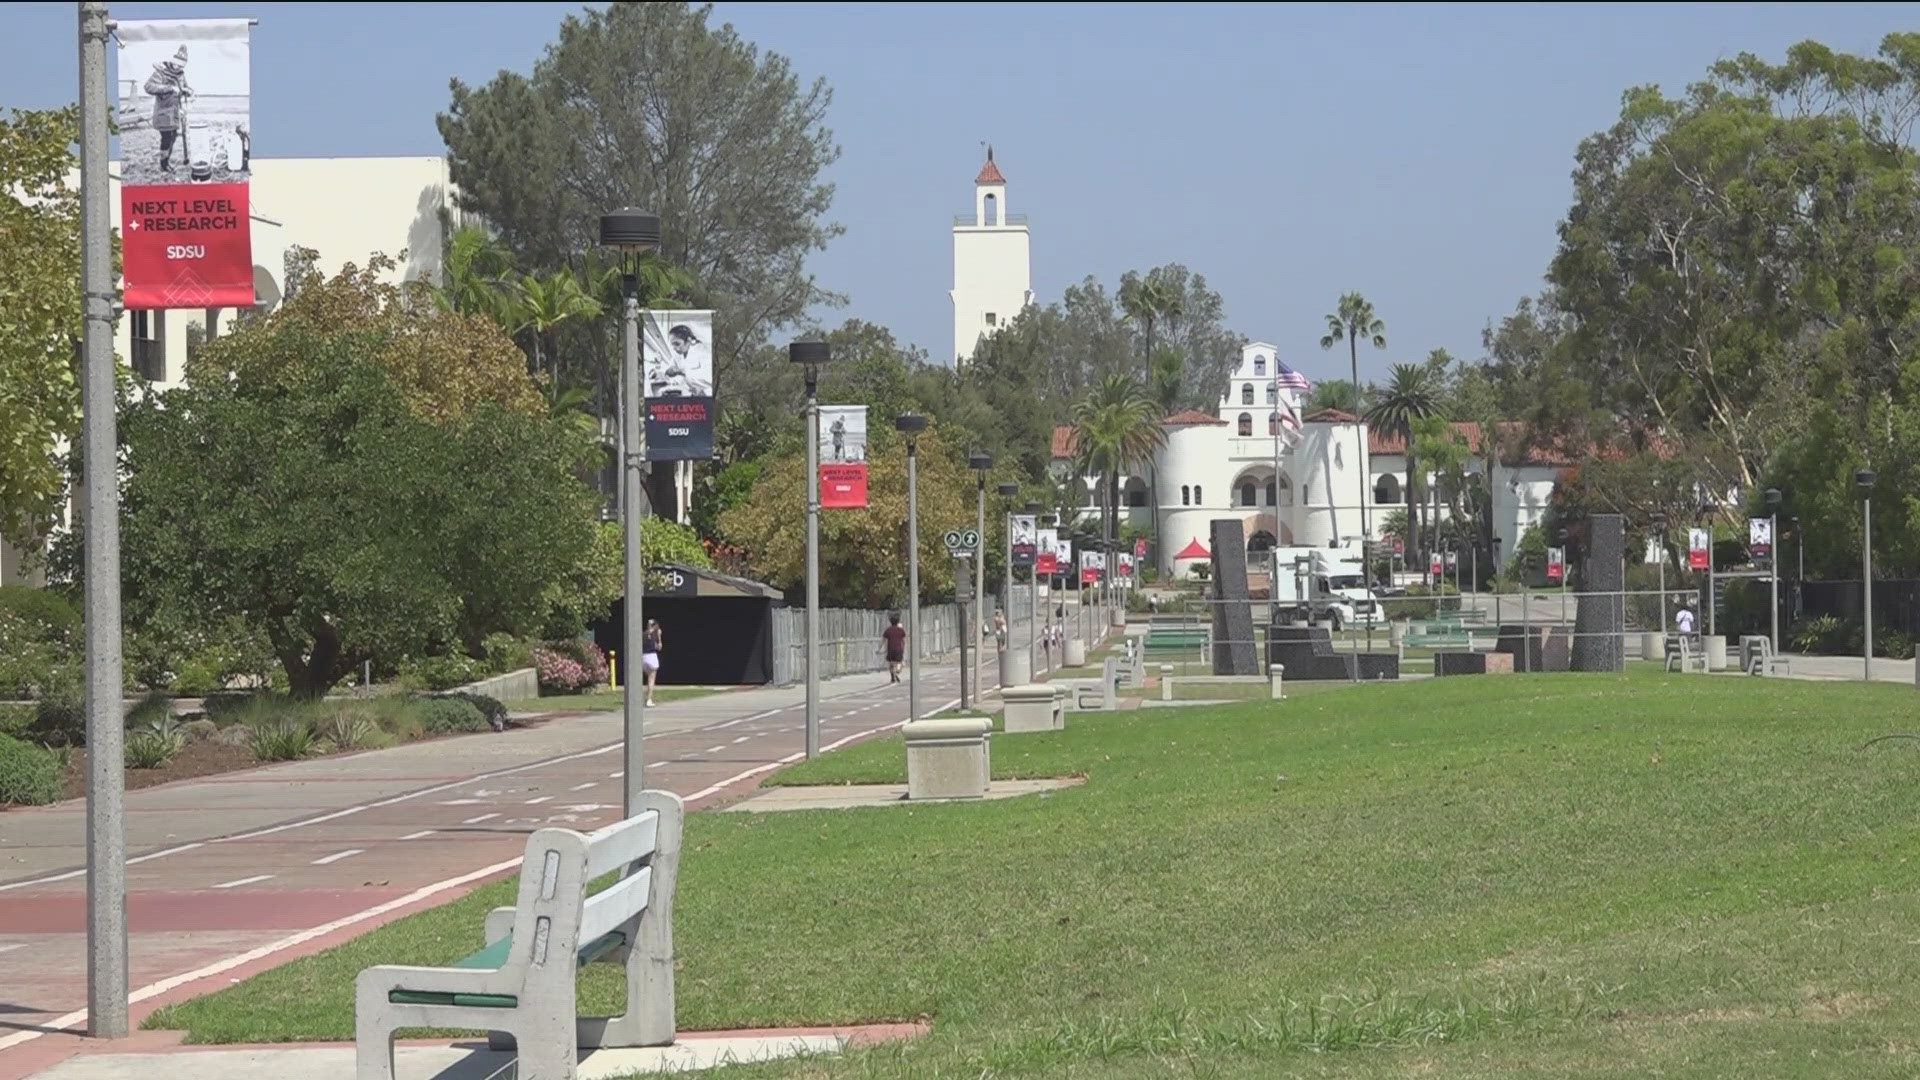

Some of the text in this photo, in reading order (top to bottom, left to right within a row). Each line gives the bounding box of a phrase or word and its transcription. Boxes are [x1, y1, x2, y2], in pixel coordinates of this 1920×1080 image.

[131, 200, 236, 215] NEXT LEVEL
[143, 216, 237, 231] RESEARCH
[167, 245, 205, 259] SDSU
[651, 403, 706, 413] NEXT LEVEL
[656, 412, 706, 421] RESEARCH
[668, 428, 689, 436] SDSU
